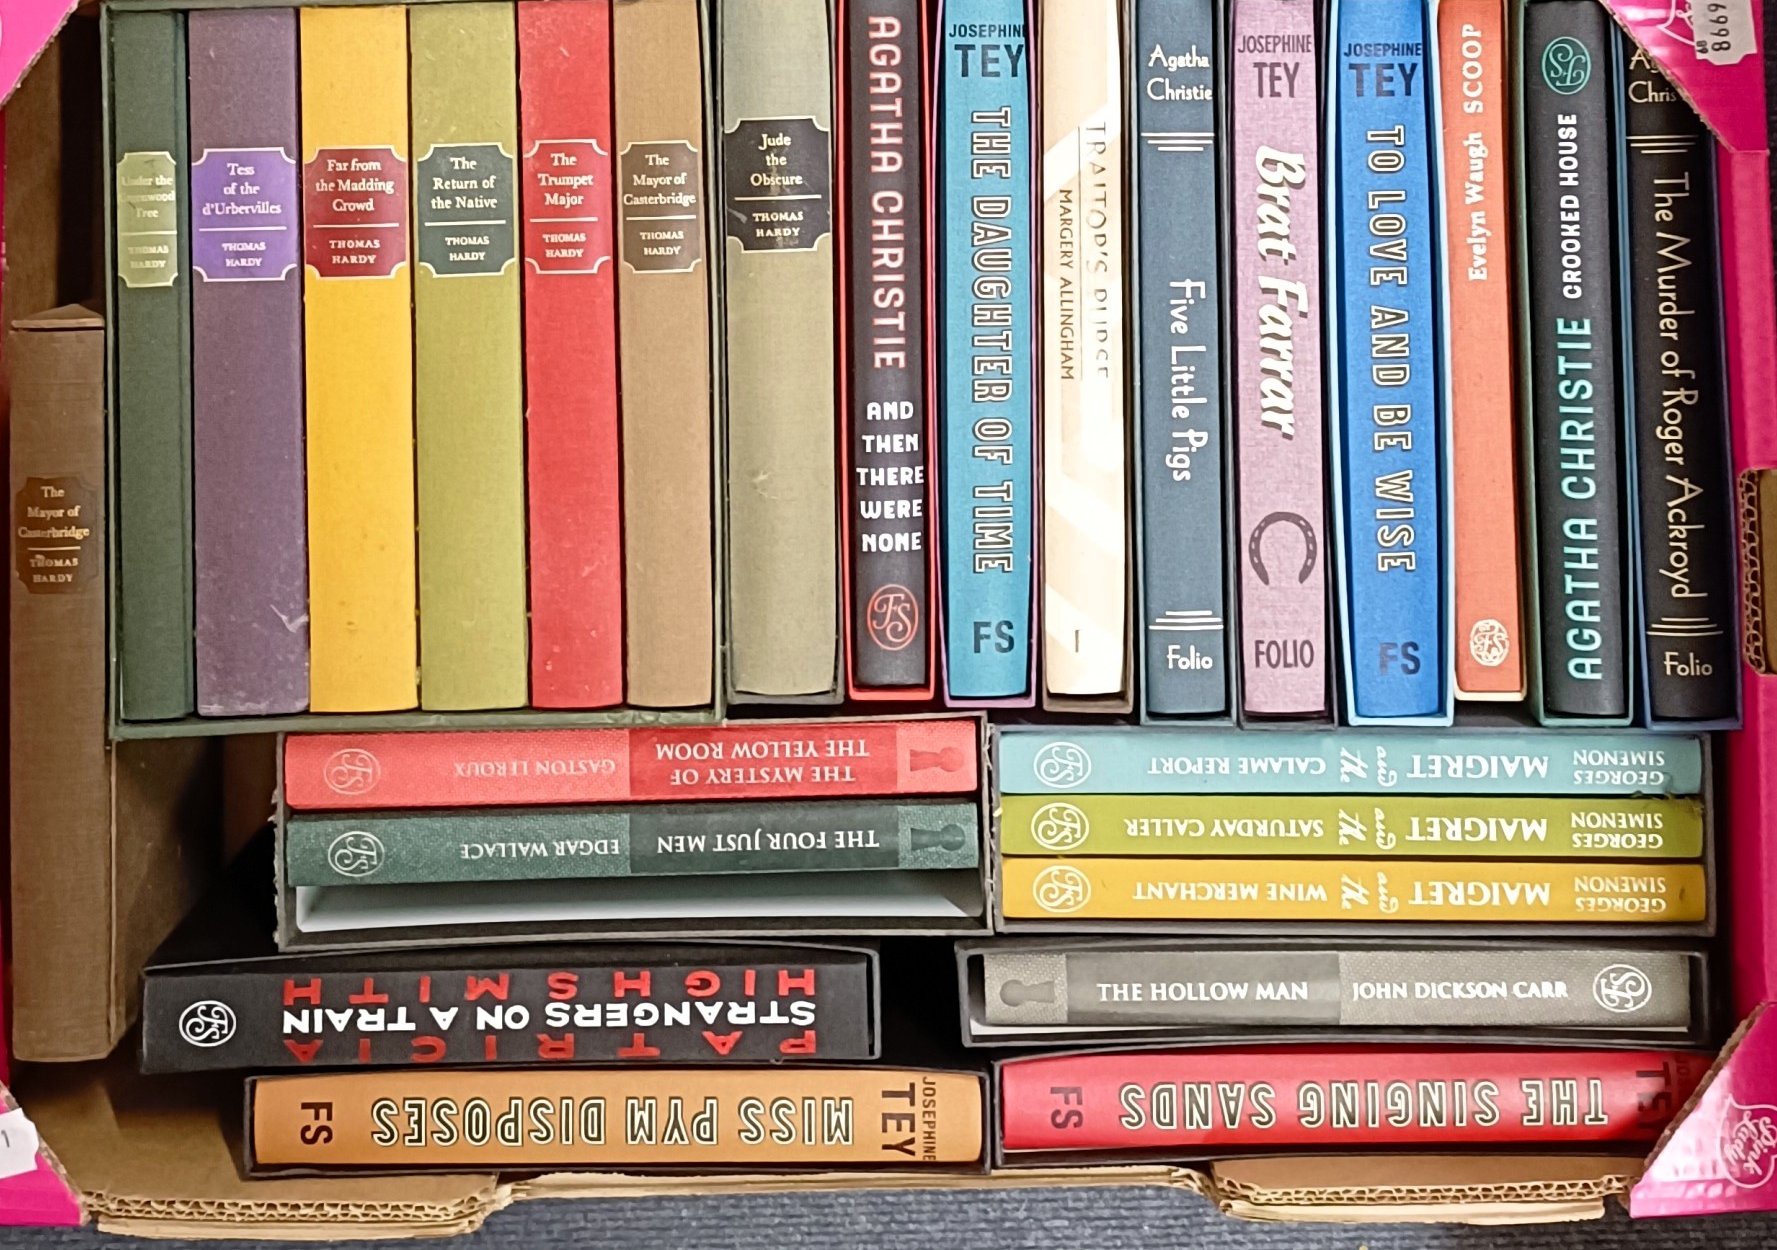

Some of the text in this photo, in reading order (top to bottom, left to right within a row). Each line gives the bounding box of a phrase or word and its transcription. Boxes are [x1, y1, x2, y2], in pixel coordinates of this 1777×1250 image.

[1238, 34, 1312, 55] JOSEPHINE
[954, 43, 1025, 78] TEY
[1148, 44, 1210, 71] Agatha
[1146, 77, 1214, 102] Christie
[758, 133, 792, 150] Jude
[1462, 23, 1492, 281] Evelyn Waugh SCOOP
[227, 162, 255, 176] Tess
[327, 158, 382, 172] Far from
[450, 157, 478, 171] The
[766, 152, 787, 167] the
[223, 183, 260, 196] of the
[315, 178, 395, 195] the Madding
[432, 174, 496, 191] Return of
[537, 173, 594, 189] Trumpet
[633, 171, 687, 189] Mayor of
[750, 172, 804, 188] Obscure
[430, 194, 498, 210] the Native
[544, 192, 584, 209] Major
[623, 191, 697, 208] Casterbridge
[868, 15, 906, 369] AGATHA CHRISTIE
[202, 202, 282, 216] d'Urbervilles
[332, 199, 375, 212] Crowd
[1558, 114, 1582, 299] CROOKED HOUSE
[752, 211, 804, 224] THOMAS
[755, 226, 801, 239] HARDY
[329, 239, 381, 249] THOMAS
[332, 254, 376, 265] HARDY
[1059, 189, 1075, 381] MARGERY ALLINGHAM
[1256, 144, 1309, 441] Brat Farrar
[970, 106, 1014, 574] THE DAUGHTER OF TIME
[1366, 124, 1416, 573] TO LOVE AND BE WISE
[1165, 278, 1209, 482] Five Little Pigs
[1653, 172, 1708, 598] The Murder of Roger Ackroyd
[866, 401, 914, 421] AND
[862, 433, 919, 453] THEN
[856, 465, 925, 486] THERE
[860, 499, 923, 520] WERE
[862, 531, 922, 553] NONE
[973, 620, 1016, 654] FS
[1166, 644, 1213, 671] Folio
[1254, 639, 1315, 669] FOLIO
[1663, 651, 1713, 677] Folio
[655, 739, 871, 761] THE YELLOW ROOM
[454, 759, 617, 778] GASTON LEROUX
[671, 766, 857, 785] THE MYSTERY OF
[1147, 756, 1327, 775] CALAME REPORT
[1406, 754, 1549, 779] MAIGRET
[1123, 818, 1324, 838] SATURDAY CALLER
[1571, 812, 1663, 829] SIMENON
[460, 838, 620, 860] EDGAR WALLACE
[1572, 833, 1664, 849] GEORGES
[1132, 881, 1328, 901] WINE MERCHANT
[1096, 982, 1308, 1001] THE HOLLOW MAN
[1352, 981, 1568, 1001] JOHN DICKSON CARR
[283, 1000, 816, 1034] STRANGERS ON A TRAIN
[1118, 1081, 1277, 1131] SANDS
[1296, 1078, 1501, 1130] SINGING
[1520, 1078, 1609, 1127] THE
[371, 1095, 855, 1147] MISS PYM DISPOSES
[880, 1081, 916, 1157] TEY
[921, 1075, 937, 1161] JOSEPHINE
[1723, 1110, 1760, 1166] Lady
[1743, 1116, 1777, 1176] Pink
